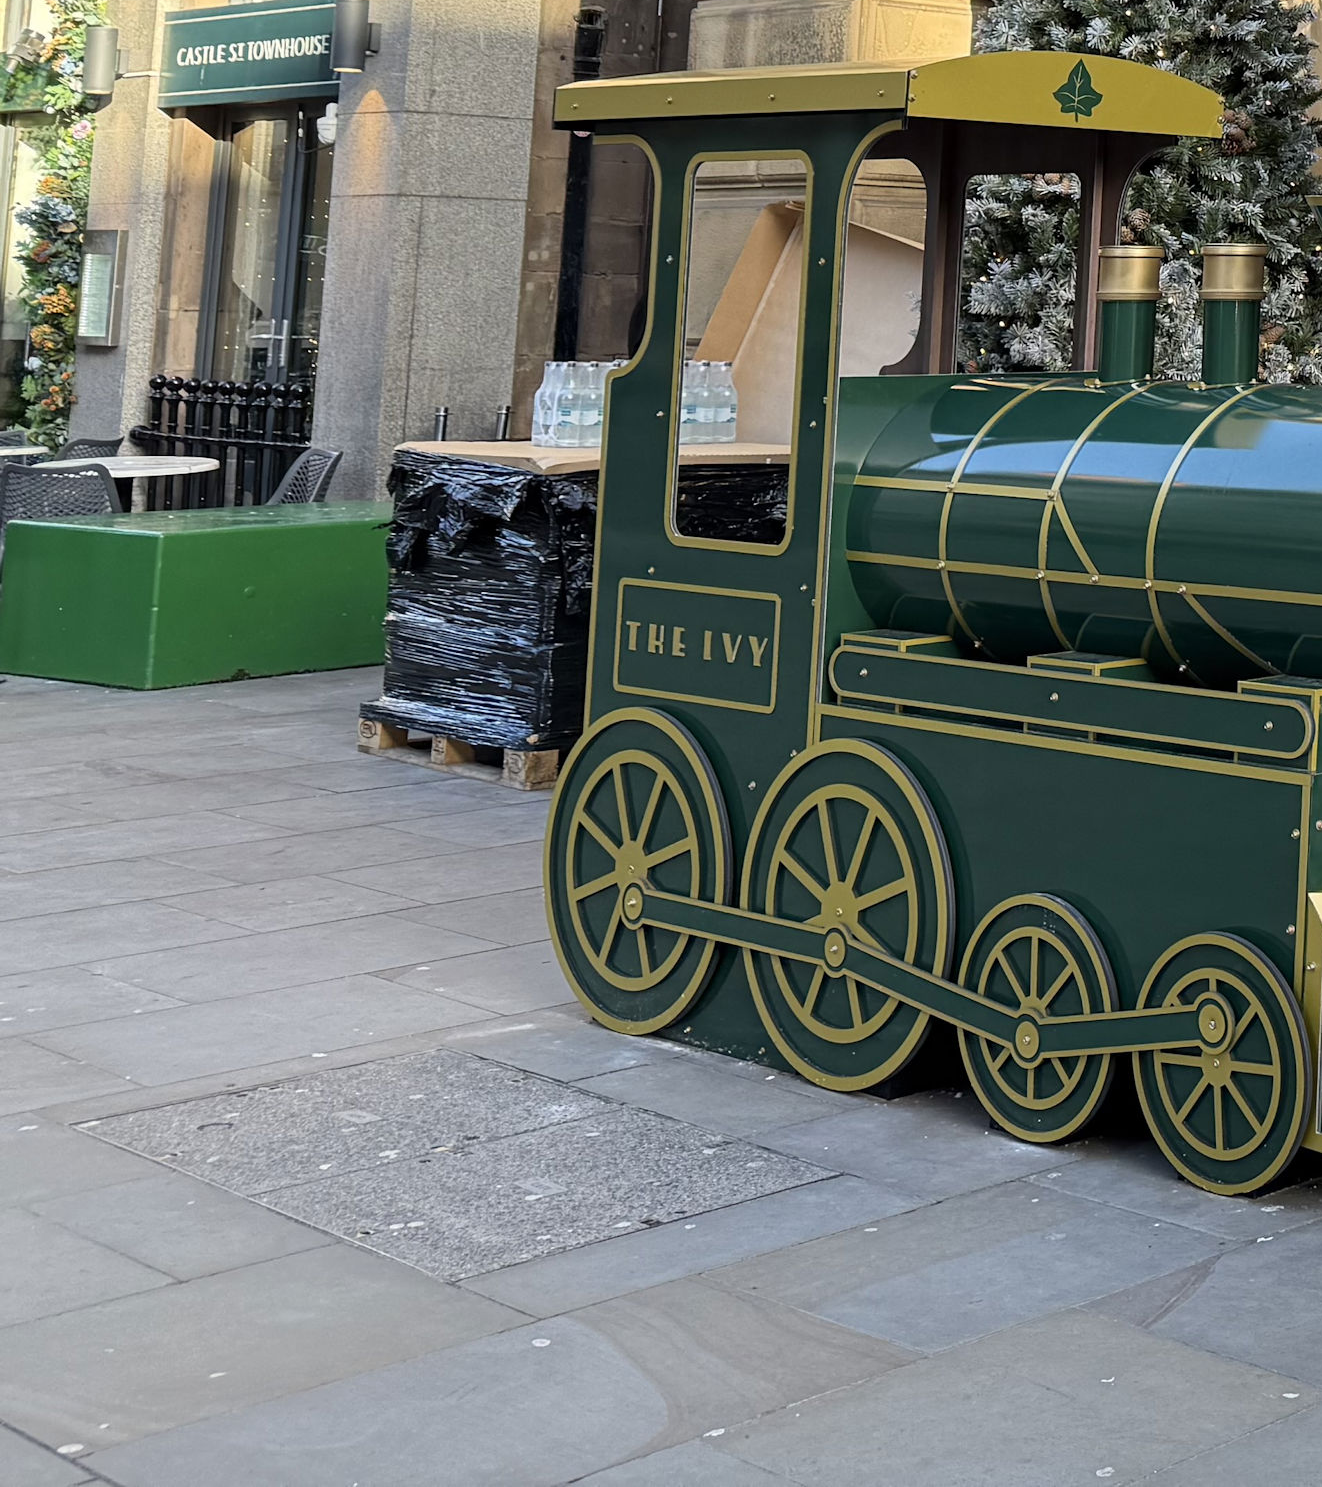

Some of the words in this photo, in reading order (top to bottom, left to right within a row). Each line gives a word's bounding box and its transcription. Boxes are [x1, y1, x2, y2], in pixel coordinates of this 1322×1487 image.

[176, 44, 227, 67] CASTLE
[247, 34, 330, 61] TOWNHOUSE
[626, 620, 686, 658] THE
[703, 629, 768, 667] IVY
